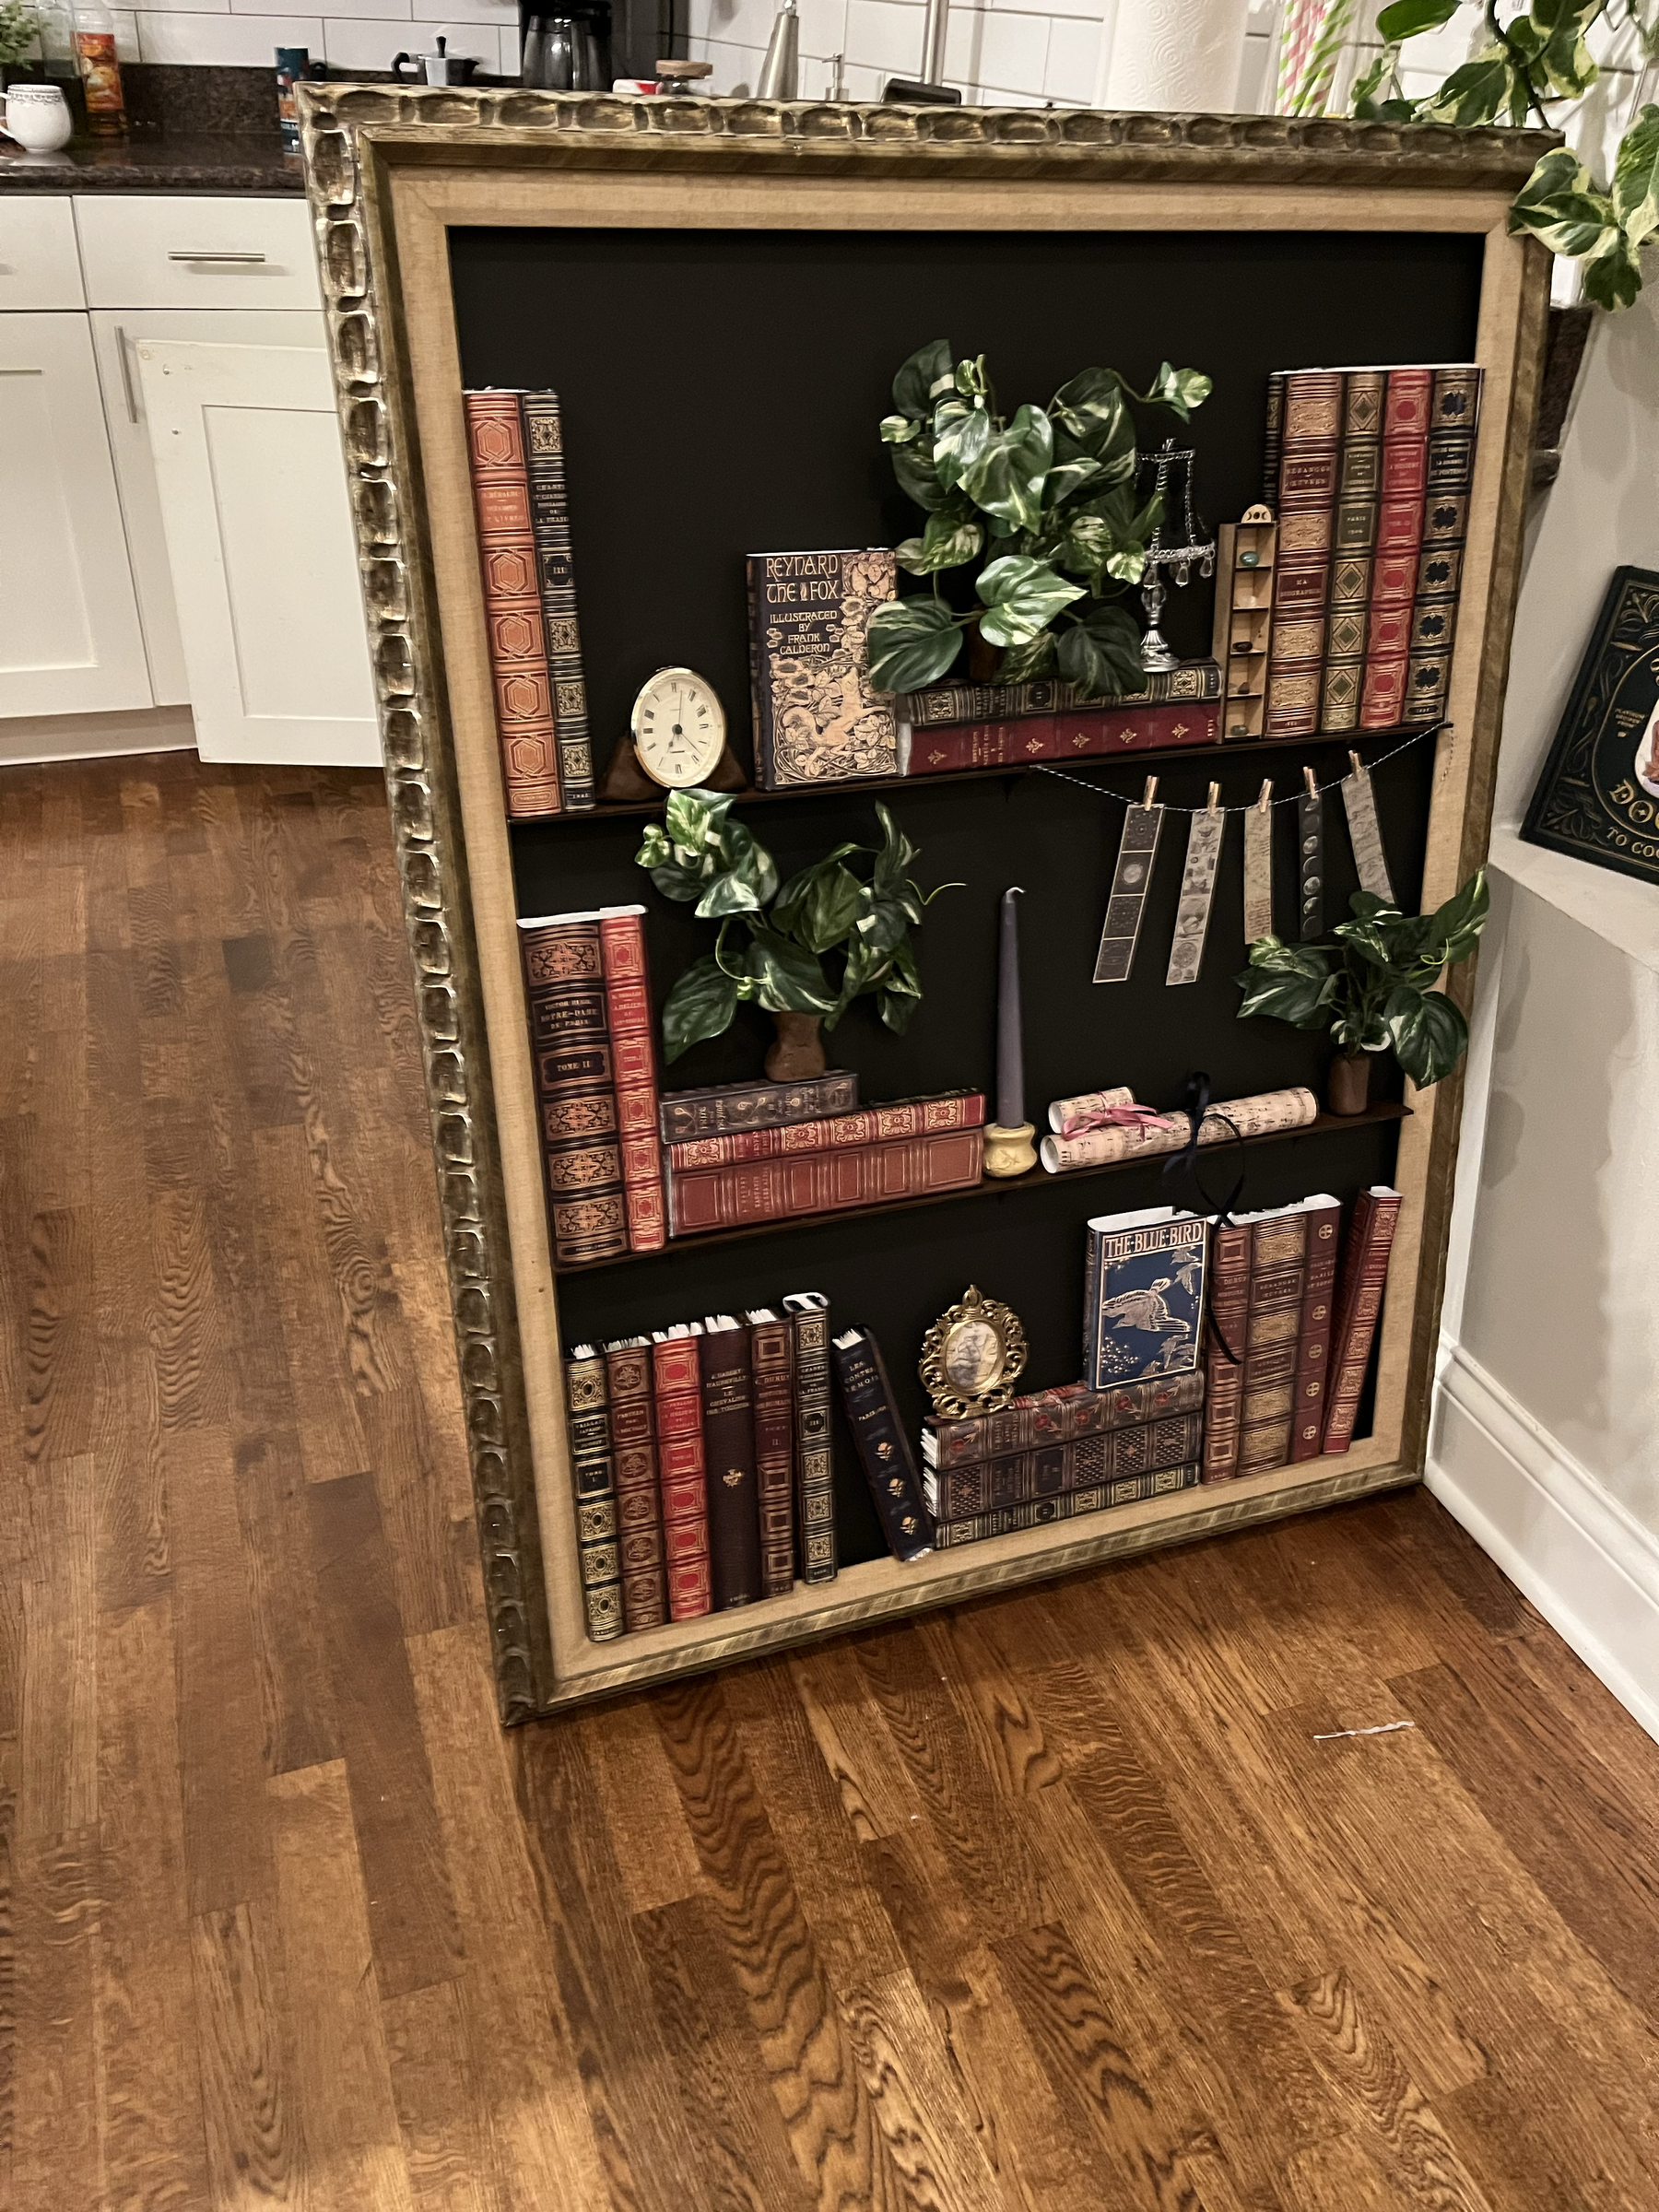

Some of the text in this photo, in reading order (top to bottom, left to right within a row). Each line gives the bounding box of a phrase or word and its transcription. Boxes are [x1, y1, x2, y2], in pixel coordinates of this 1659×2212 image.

[766, 553, 840, 582] REYNARD
[766, 579, 840, 604] THE FOX
[770, 609, 838, 624] ILLUSTRATED
[798, 622, 811, 633] BY
[787, 632, 820, 644] FRANK
[780, 642, 830, 656] CALDERON
[1608, 779, 1659, 830] DO
[1606, 827, 1659, 860] TO CO
[557, 1060, 580, 1071] TOME
